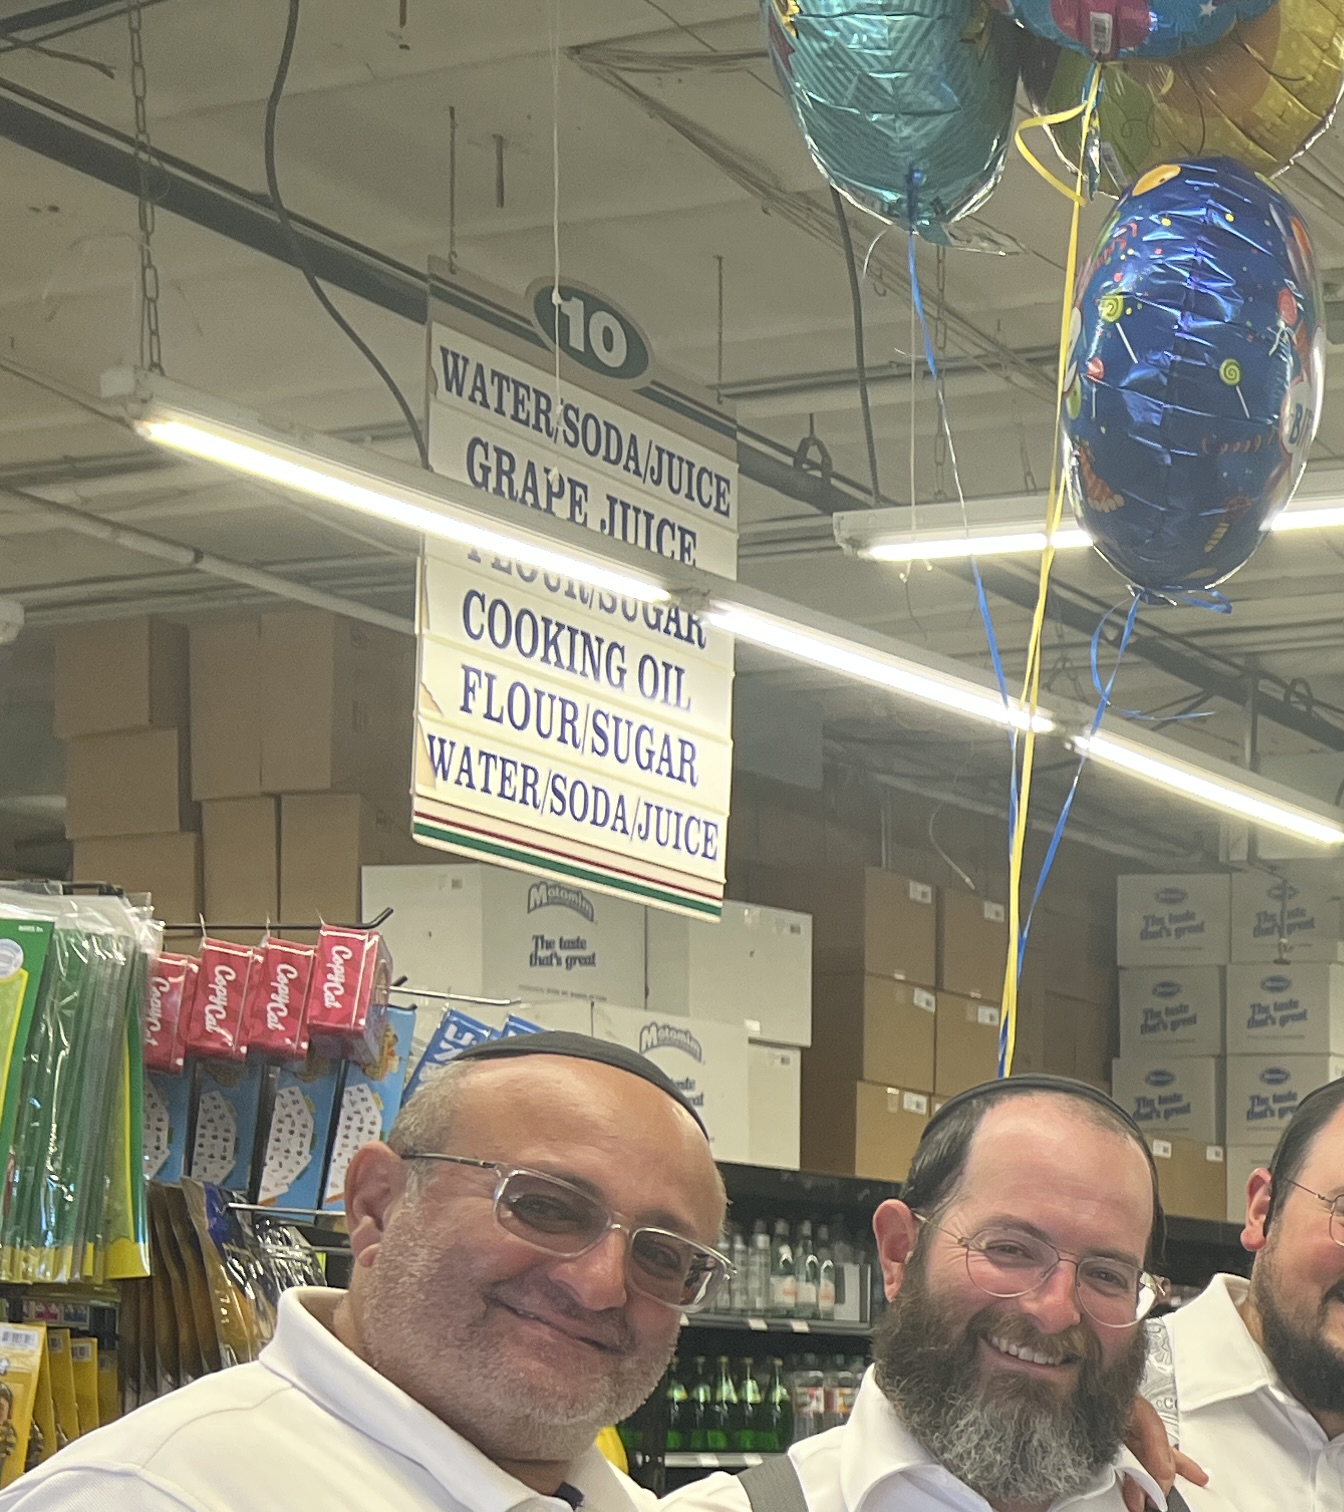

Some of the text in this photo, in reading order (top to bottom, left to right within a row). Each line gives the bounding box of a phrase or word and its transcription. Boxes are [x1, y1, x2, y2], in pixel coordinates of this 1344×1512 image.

[559, 296, 626, 367] 10
[440, 346, 731, 518] WATER/SODA/JUICE
[466, 436, 698, 568] GRAPE JUICE
[462, 589, 691, 711] COOKING OIL
[461, 664, 698, 787] FLOUR/SUGAR
[428, 734, 719, 860] WATER/SODA/JUICE
[530, 951, 596, 970] that's great
[532, 935, 587, 950] The taste
